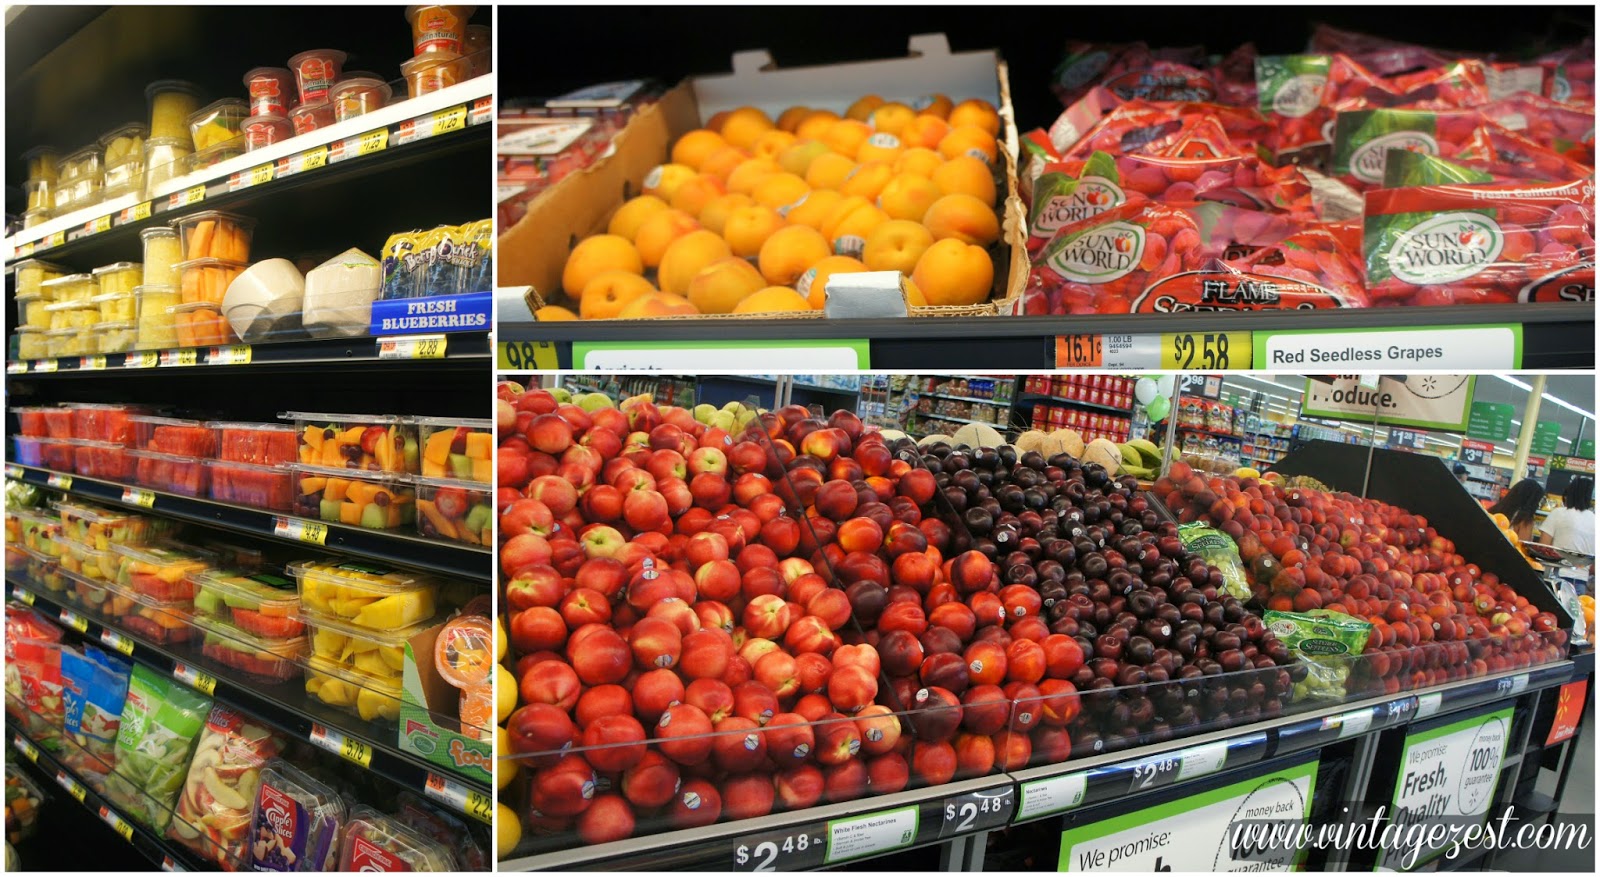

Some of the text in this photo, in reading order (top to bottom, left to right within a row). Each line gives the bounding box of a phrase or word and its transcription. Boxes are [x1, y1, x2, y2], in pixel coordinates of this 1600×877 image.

[1514, 186, 1579, 198] California
[1074, 235, 1115, 251] SUN
[1412, 233, 1459, 249] SUN
[1064, 249, 1131, 270] WORLD
[1405, 247, 1487, 268] WORLD
[1203, 280, 1278, 304] FLAME
[407, 300, 456, 315] FRESH
[382, 314, 486, 330] BLUEBERRIES
[418, 340, 438, 355] $2.88
[1123, 335, 1132, 343] LB
[1174, 334, 1229, 369] $2.58
[1273, 346, 1443, 363] Red Seedless Grapes
[1313, 384, 1397, 409] oduce.
[208, 712, 230, 728] Slices
[346, 737, 364, 760] $5.78
[1410, 744, 1448, 764] We promise:
[1470, 747, 1499, 772] 100%
[1402, 761, 1448, 799] Fresh,
[1464, 773, 1493, 789] guarantee
[1245, 799, 1294, 819] money back
[1395, 794, 1451, 828] Quality
[274, 823, 292, 838] Slices
[834, 818, 897, 835] White Flesh Nectarines
[1079, 850, 1105, 871] We
[1108, 831, 1171, 868] promise:
